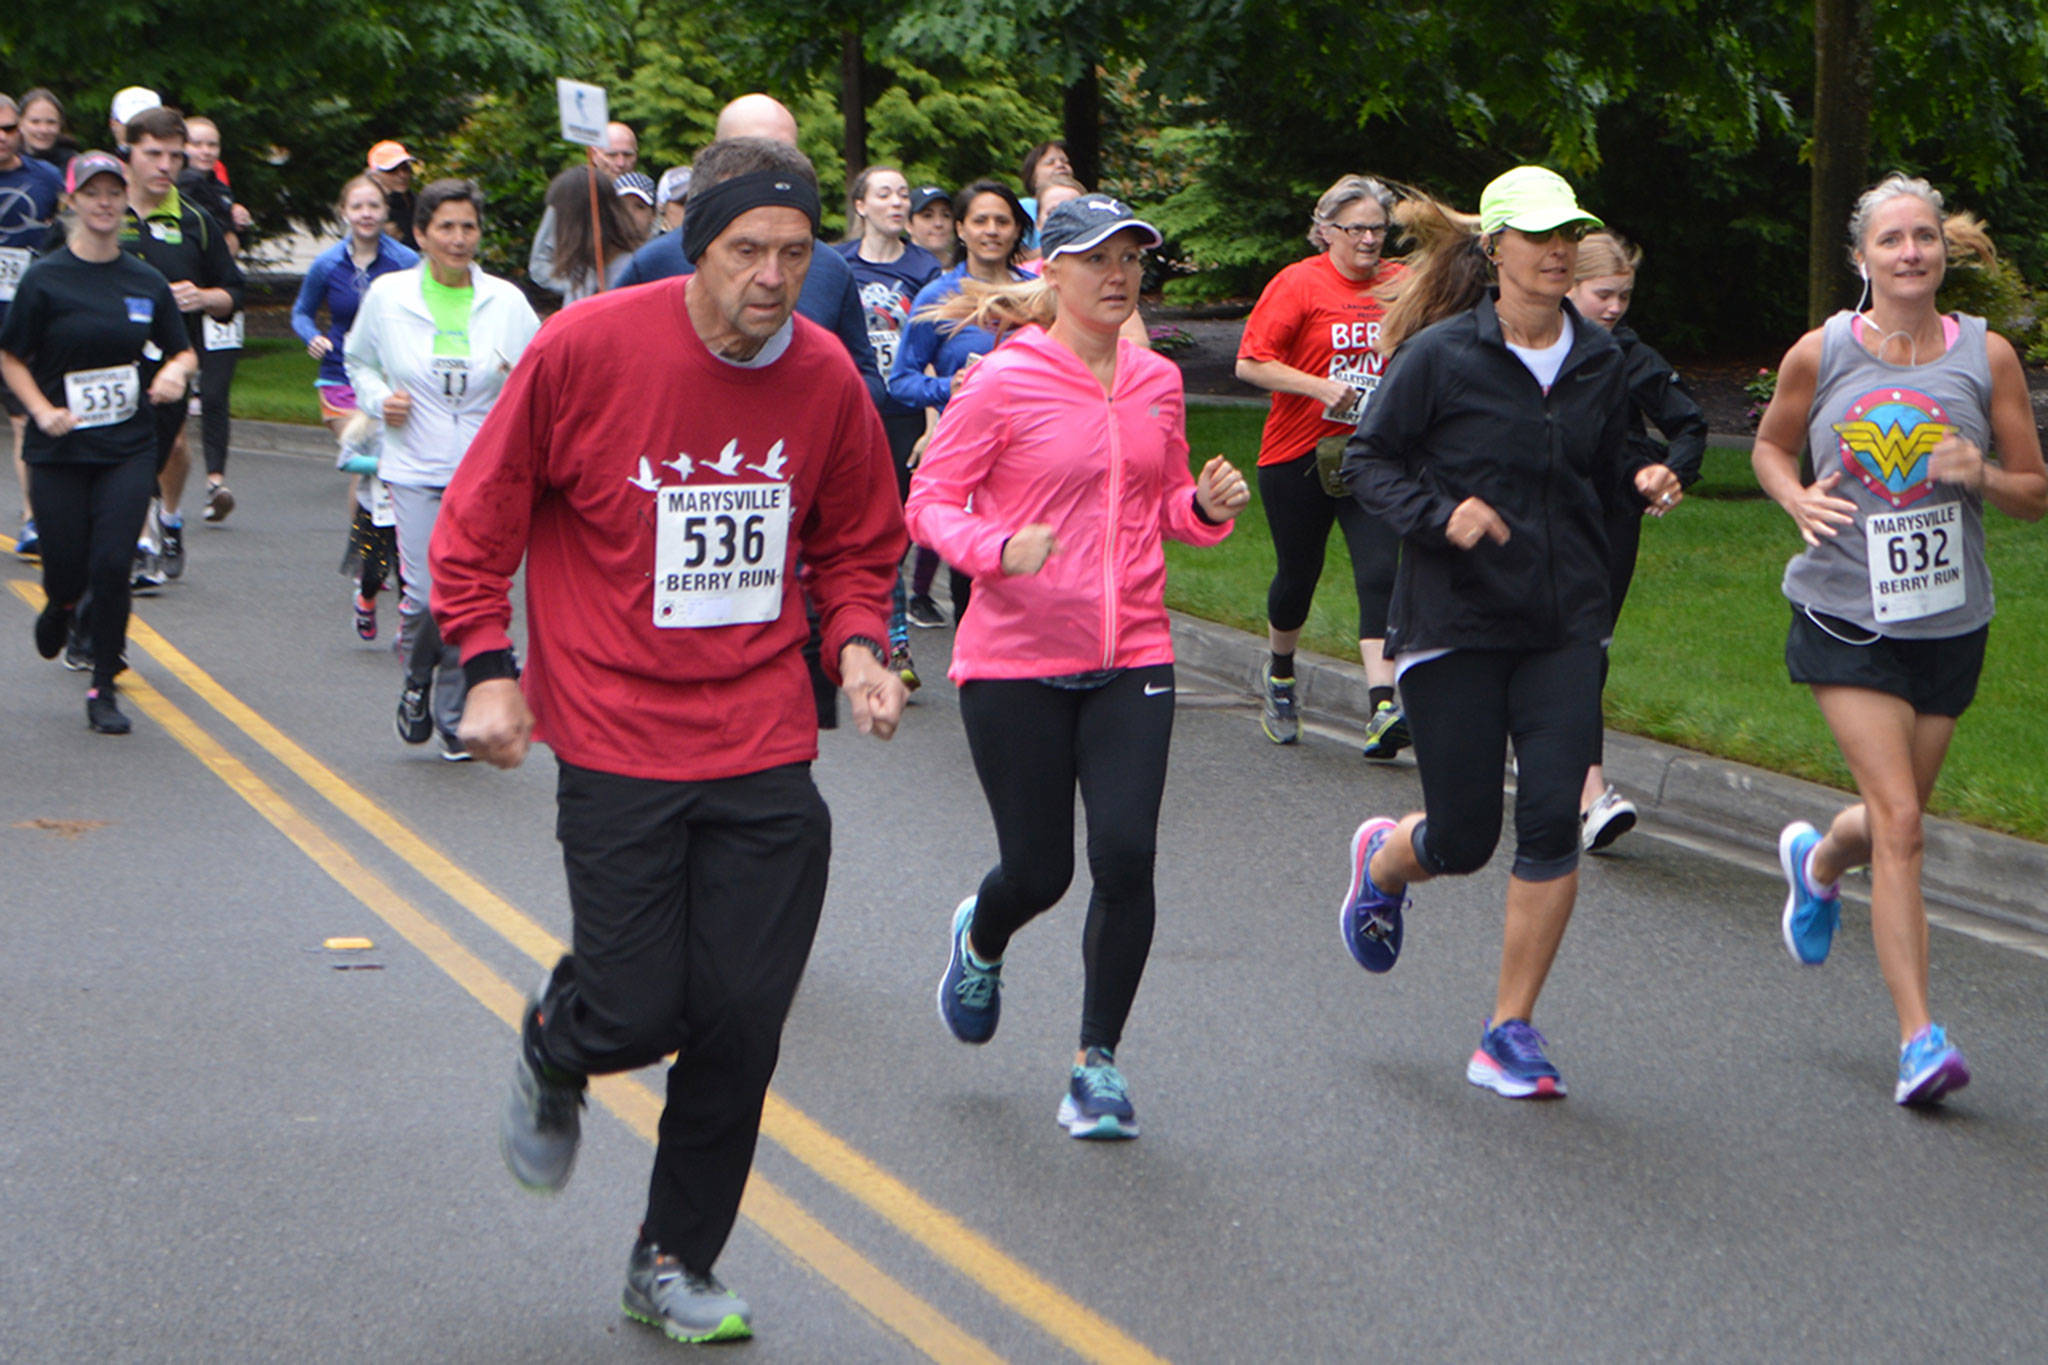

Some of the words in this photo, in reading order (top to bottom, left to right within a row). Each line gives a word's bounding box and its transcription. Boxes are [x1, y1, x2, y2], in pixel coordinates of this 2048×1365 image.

[1331, 322, 1381, 350] BER
[82, 383, 127, 411] 535
[668, 488, 781, 512] MARYSVILLE
[1873, 506, 1956, 535] MARYSVILLE
[683, 514, 765, 568] 536
[1887, 528, 1950, 575] 632
[666, 571, 733, 592] BERRY
[738, 568, 776, 589] RUN
[1878, 574, 1930, 595] BERRY
[1933, 567, 1960, 586] RUN
